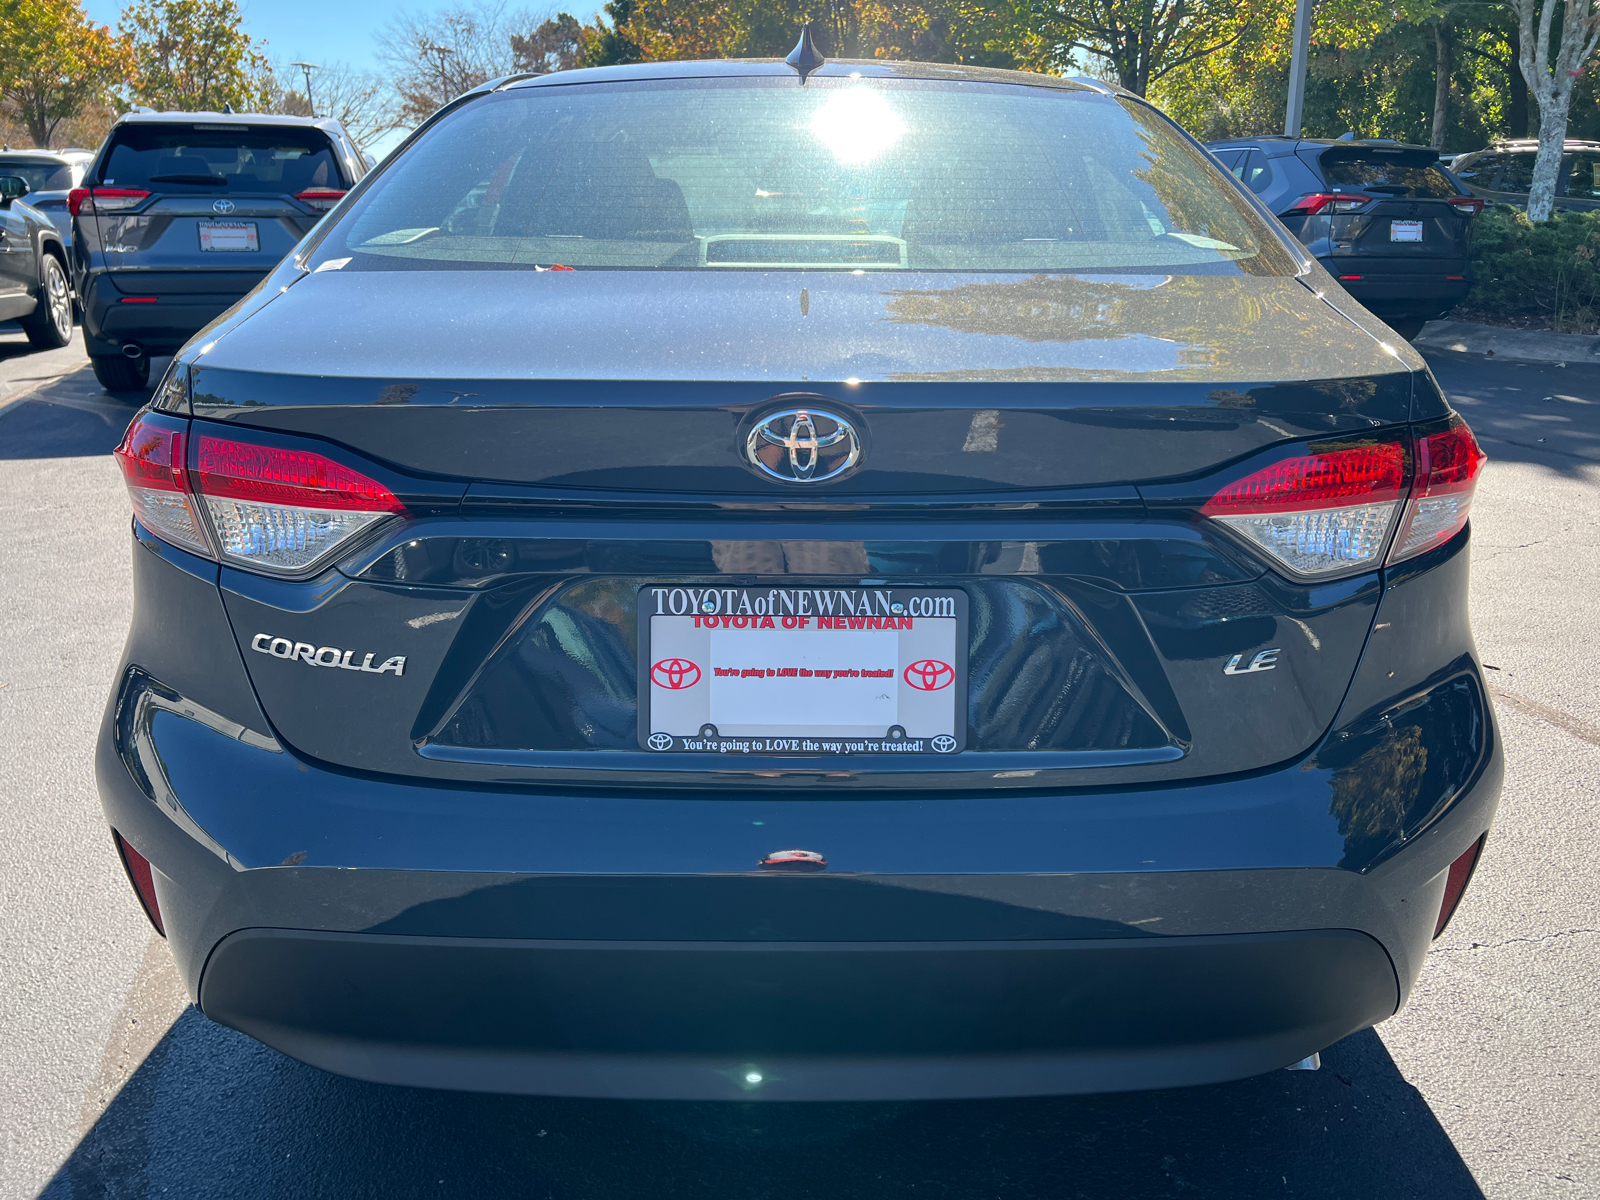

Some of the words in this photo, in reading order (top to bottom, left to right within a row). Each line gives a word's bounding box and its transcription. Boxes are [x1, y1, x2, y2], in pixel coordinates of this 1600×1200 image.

[690, 615, 775, 629] TOYOTA
[781, 615, 810, 629] OF
[817, 616, 913, 630] NEWNAN
[251, 633, 408, 676] COROLLA
[1223, 648, 1281, 676] LE
[714, 667, 740, 677] You're
[741, 668, 765, 679] going
[766, 668, 775, 677] to
[776, 668, 798, 677] LOVE
[799, 668, 813, 677] the
[814, 670, 832, 679] way
[833, 669, 860, 679] you're
[861, 669, 894, 678] treated!
[682, 738, 718, 750] You're
[720, 739, 750, 753] going
[752, 740, 763, 750] to
[765, 739, 800, 751] LOVE
[802, 739, 820, 751] the
[822, 741, 843, 754] way
[845, 740, 879, 754] you're
[881, 740, 924, 752] treated!
